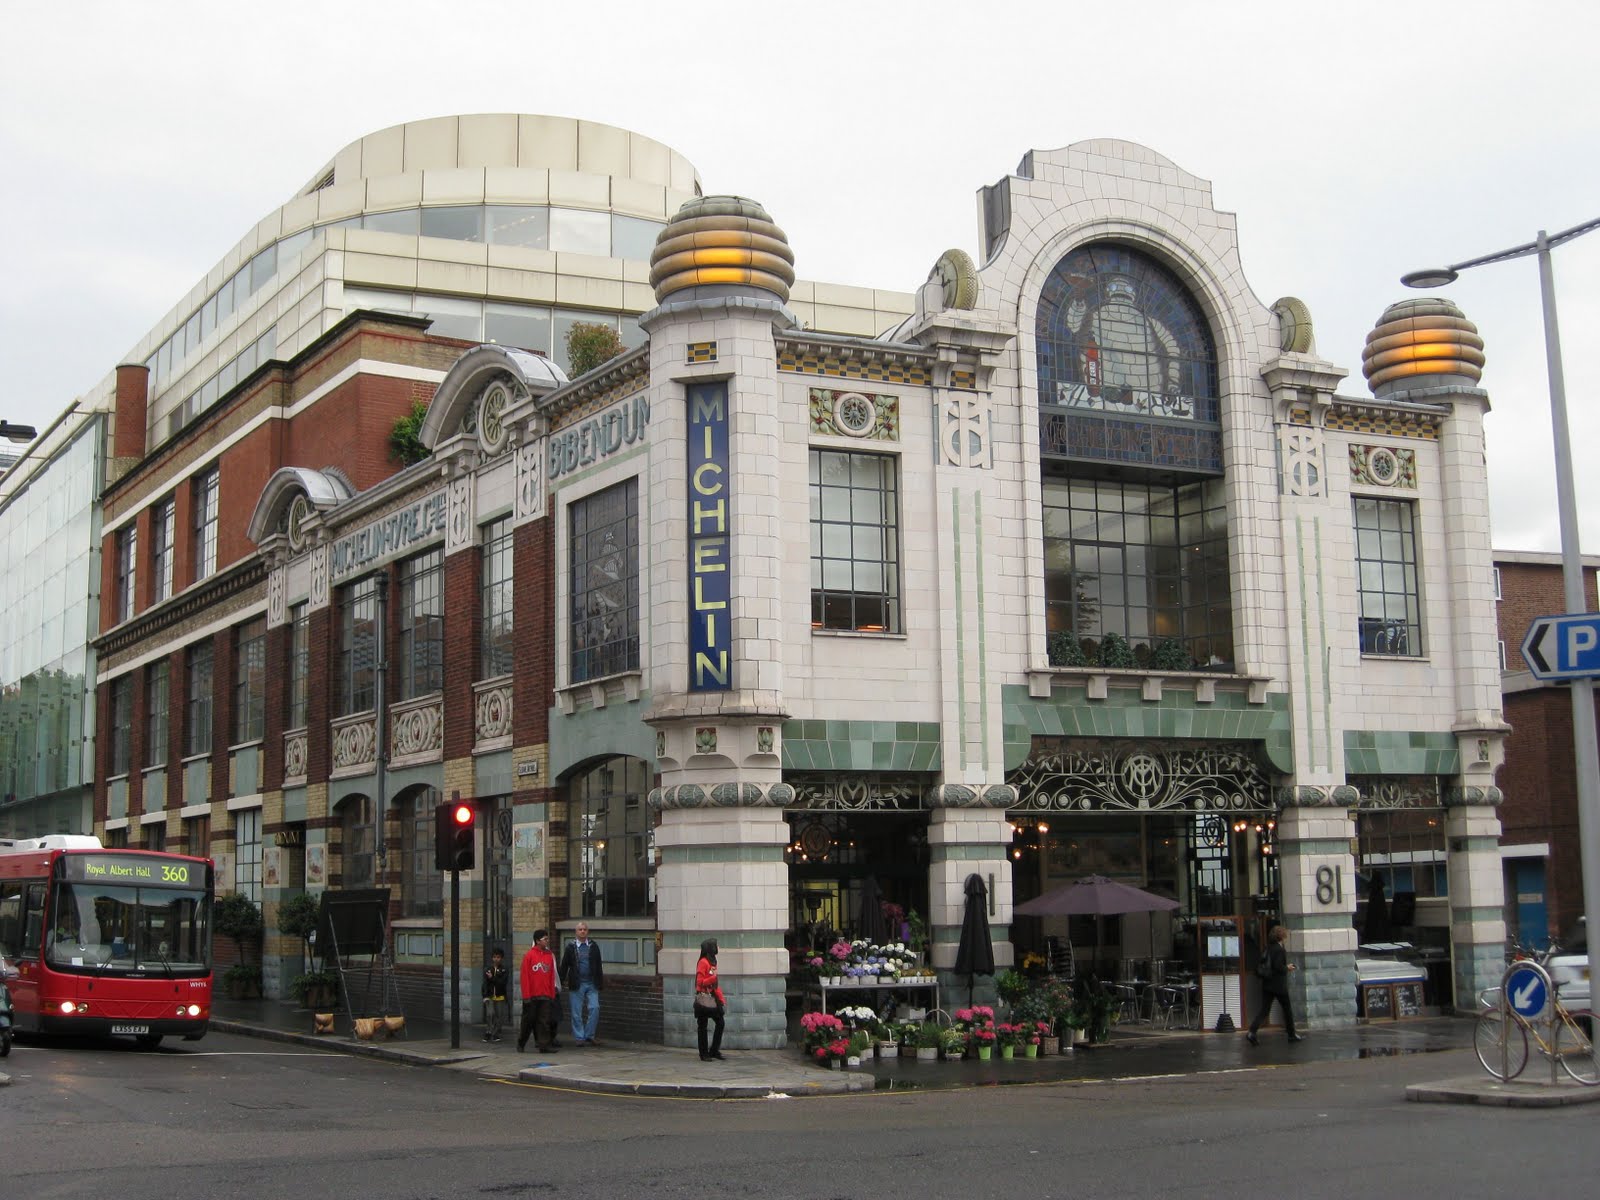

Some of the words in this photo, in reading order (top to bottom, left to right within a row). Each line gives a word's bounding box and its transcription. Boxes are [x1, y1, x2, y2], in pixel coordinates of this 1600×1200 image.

[692, 390, 728, 687] MICHELIN
[1567, 625, 1597, 668] P
[86, 863, 107, 877] Royal
[110, 864, 133, 876] Albert
[135, 866, 151, 877] Hall
[161, 865, 188, 882] 360
[1316, 864, 1342, 905] 81
